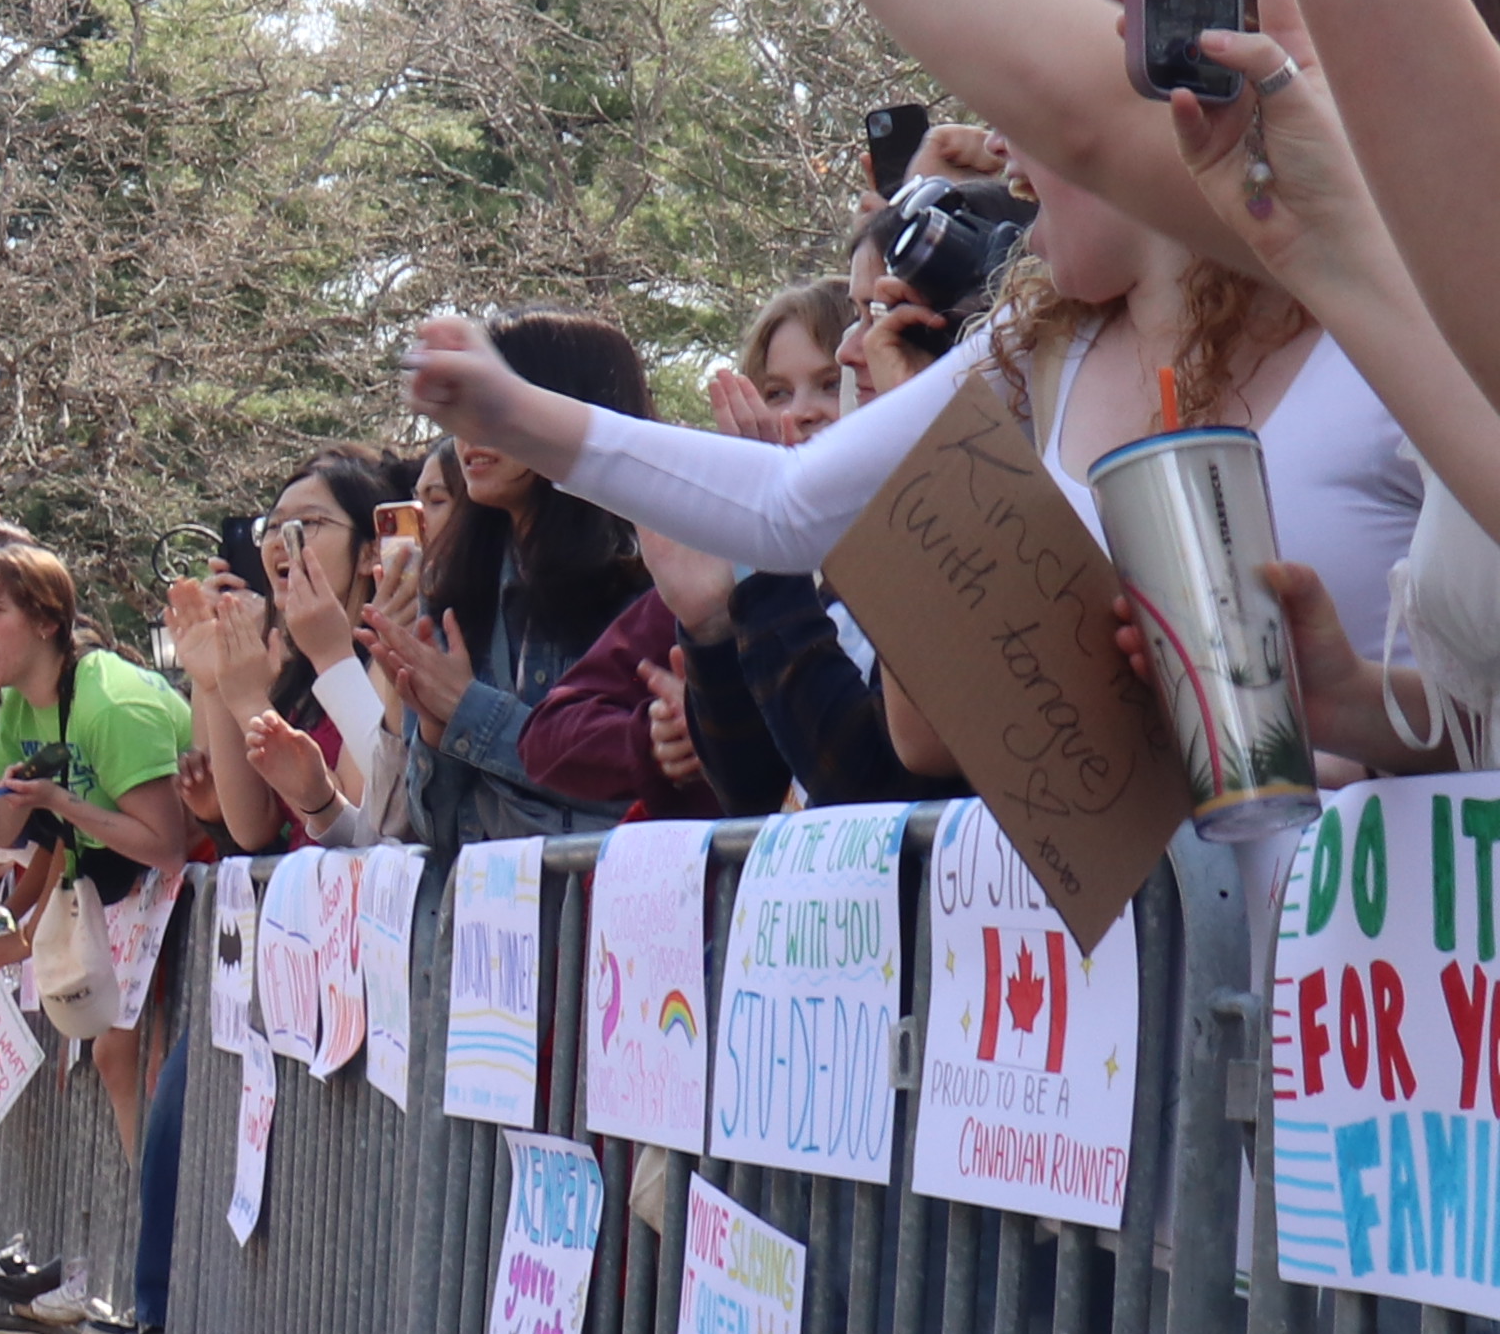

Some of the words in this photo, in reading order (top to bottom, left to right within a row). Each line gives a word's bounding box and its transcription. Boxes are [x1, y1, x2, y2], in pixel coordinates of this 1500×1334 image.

[992, 622, 1136, 816] tongue)
[791, 824, 831, 874] THE
[826, 816, 899, 875] COURSE
[937, 803, 982, 914] GO
[1305, 794, 1388, 939] DO
[1432, 794, 1500, 962] IT
[755, 900, 782, 968] BE
[786, 900, 829, 969] WITH
[835, 898, 881, 969] YOU
[0, 1033, 28, 1078] WHAT
[1298, 959, 1417, 1102] FOR
[930, 1059, 989, 1108] PROUD
[995, 1069, 1016, 1111] TO
[1023, 1074, 1048, 1117] BE
[1055, 1078, 1071, 1119] A
[958, 1115, 1047, 1187] CANADIAN
[1049, 1131, 1128, 1210] RUNNER
[681, 1268, 696, 1324] IT
[689, 1186, 729, 1269] YOU'RE
[727, 1216, 796, 1312] SLAYING
